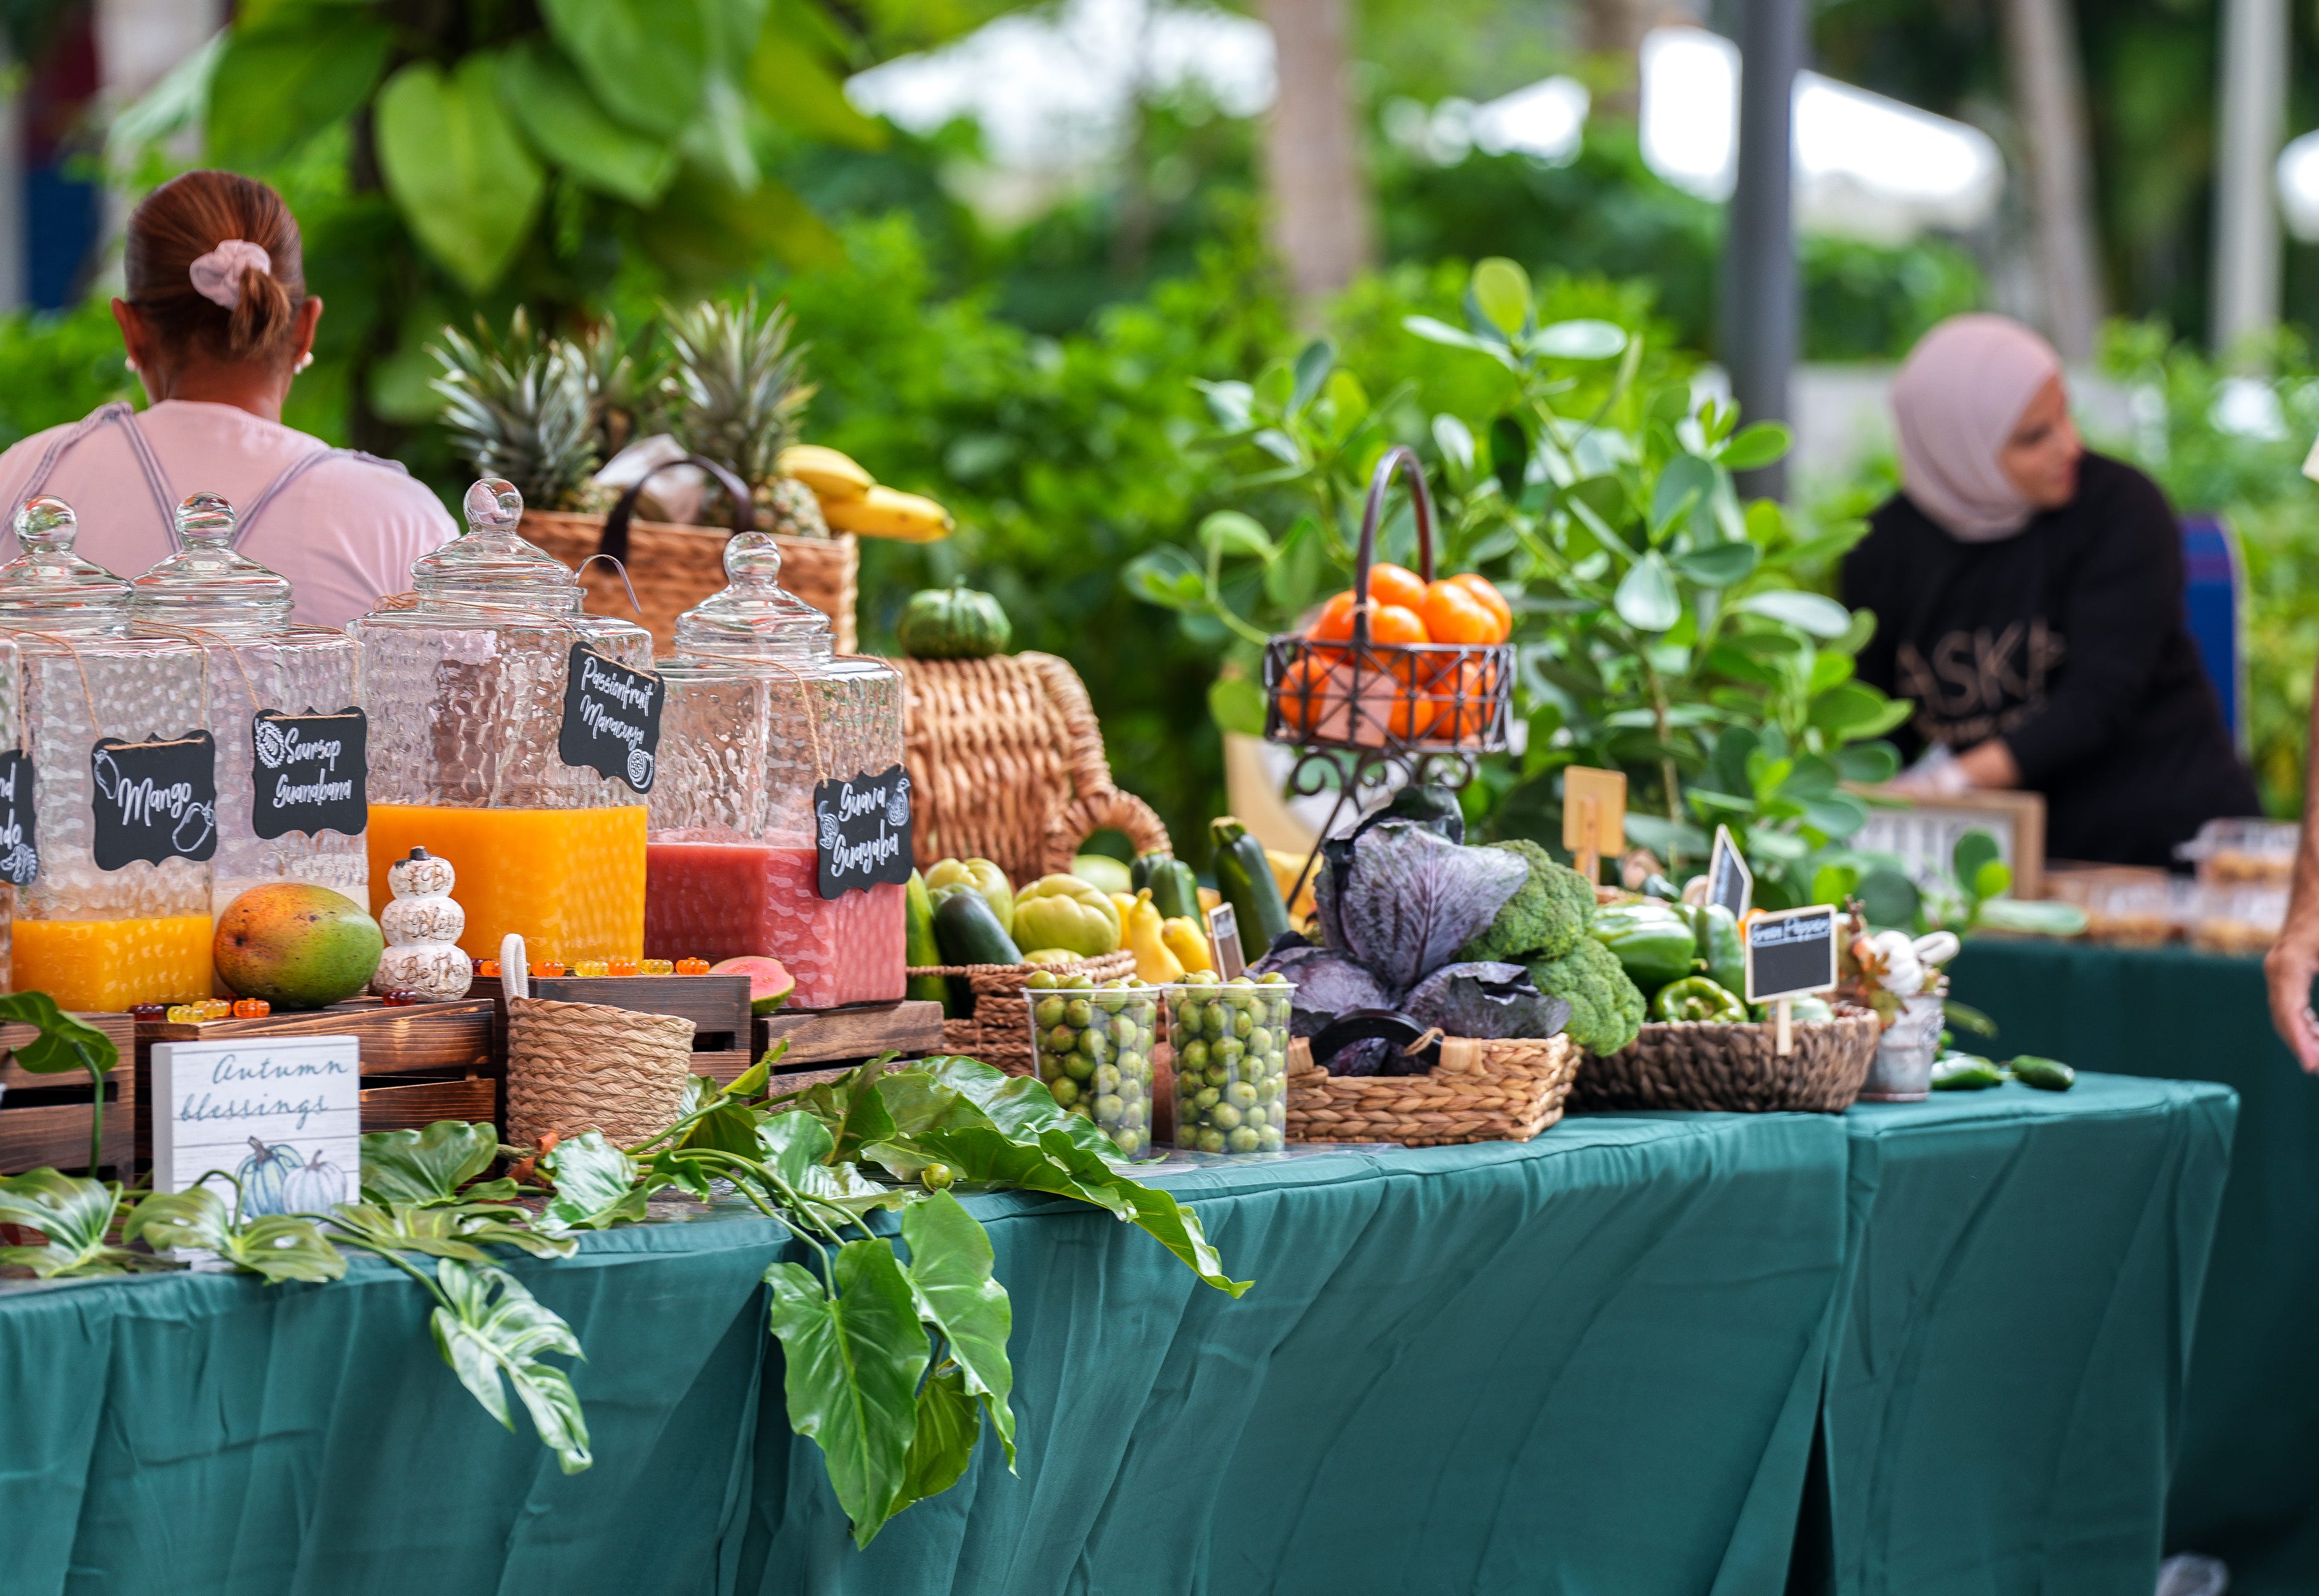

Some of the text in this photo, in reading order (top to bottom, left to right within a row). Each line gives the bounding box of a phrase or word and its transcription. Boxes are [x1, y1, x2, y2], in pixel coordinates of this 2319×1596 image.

[581, 656, 654, 717] Passionfruit
[580, 695, 644, 751] Maracuya
[285, 727, 341, 771] Soursop
[118, 777, 192, 827] Mango
[272, 768, 352, 808] Guanabana
[838, 782, 886, 822] Guava
[830, 819, 899, 877] Guayaba
[213, 1053, 348, 1084] Autumn
[179, 1092, 327, 1130] blessings
